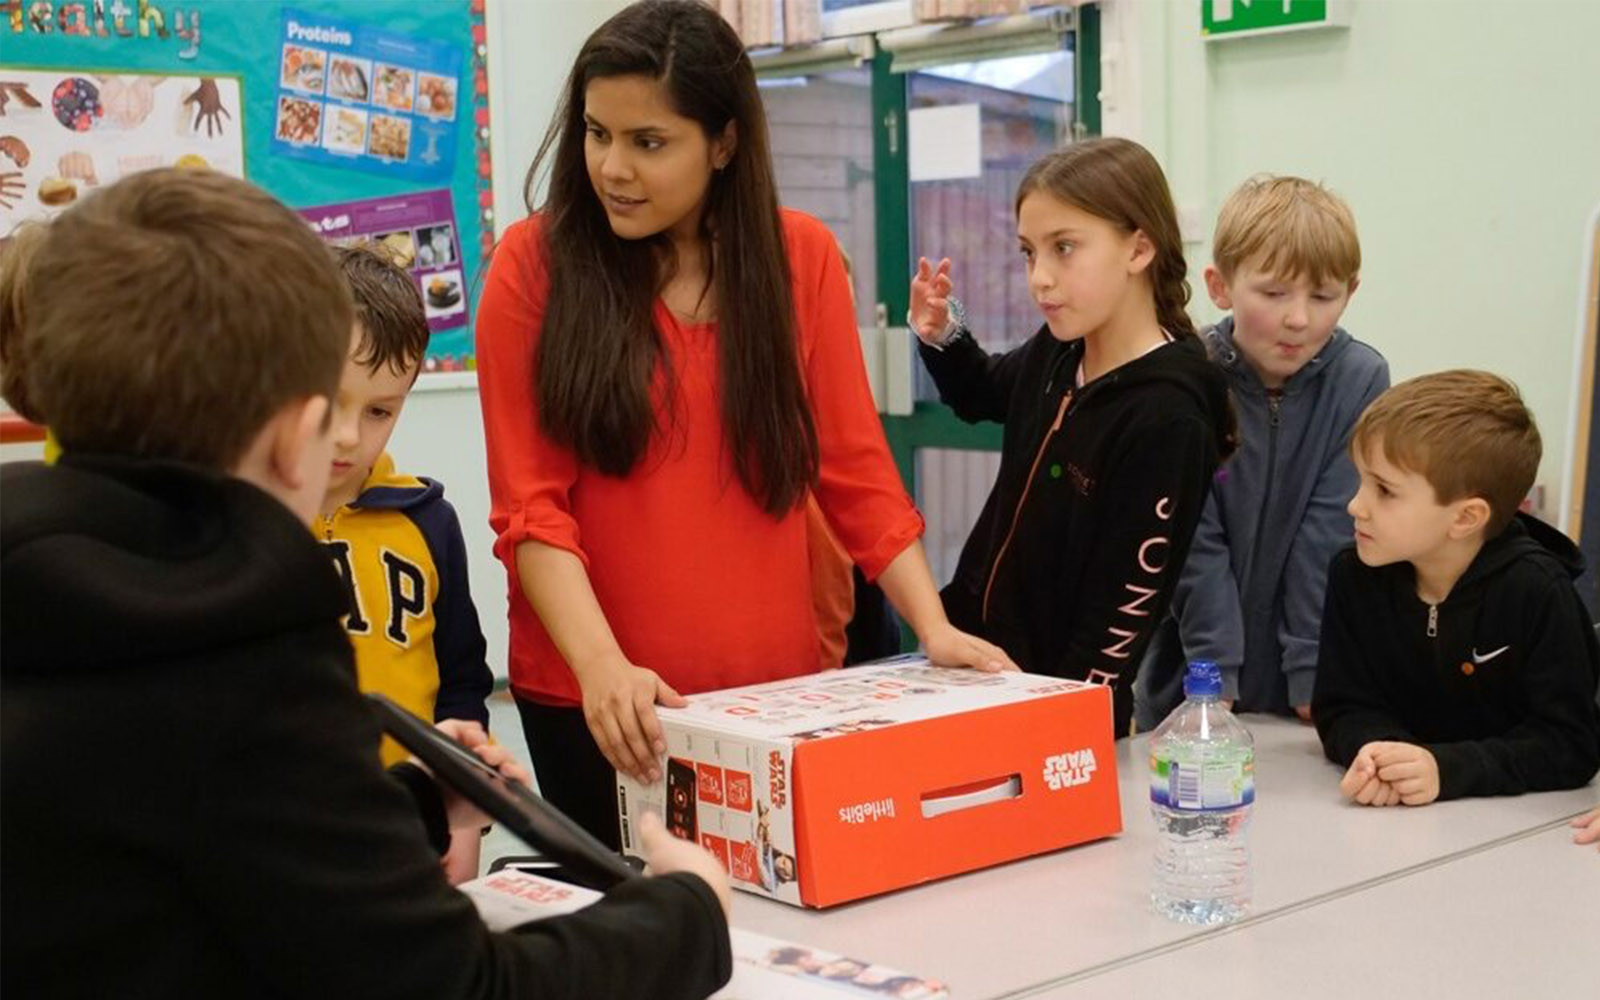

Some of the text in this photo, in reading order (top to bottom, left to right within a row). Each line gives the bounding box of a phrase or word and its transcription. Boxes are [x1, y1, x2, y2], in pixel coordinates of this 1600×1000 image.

[287, 21, 352, 46] Proteins
[1045, 748, 1096, 773] WARS
[1044, 767, 1096, 790] STAR
[838, 797, 896, 824] littleBits
